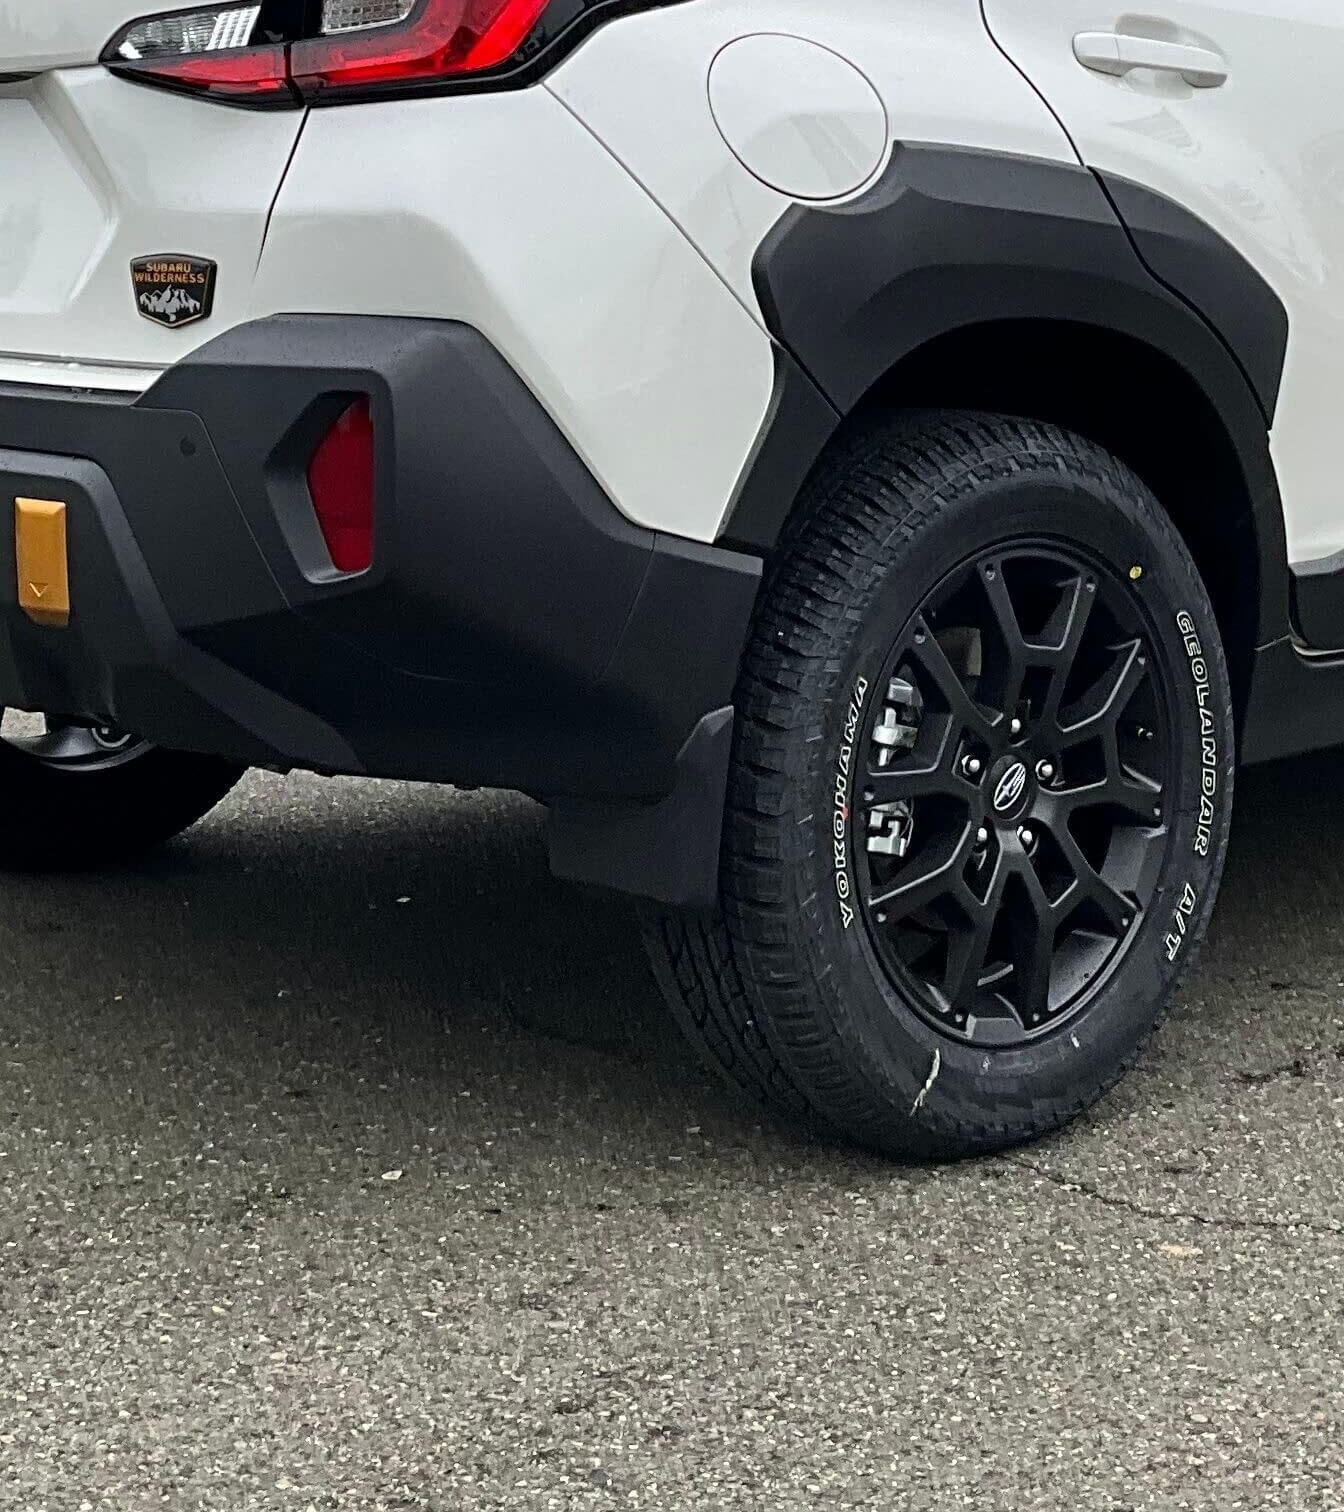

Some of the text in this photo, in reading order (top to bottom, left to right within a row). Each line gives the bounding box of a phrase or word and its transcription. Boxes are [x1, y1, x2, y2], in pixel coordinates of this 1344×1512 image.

[135, 273, 205, 284] WILDERNESS
[146, 263, 191, 273] SUBARU
[834, 676, 868, 928] YOKOHAMA
[1165, 610, 1216, 961] GEOLANDAR A/T
